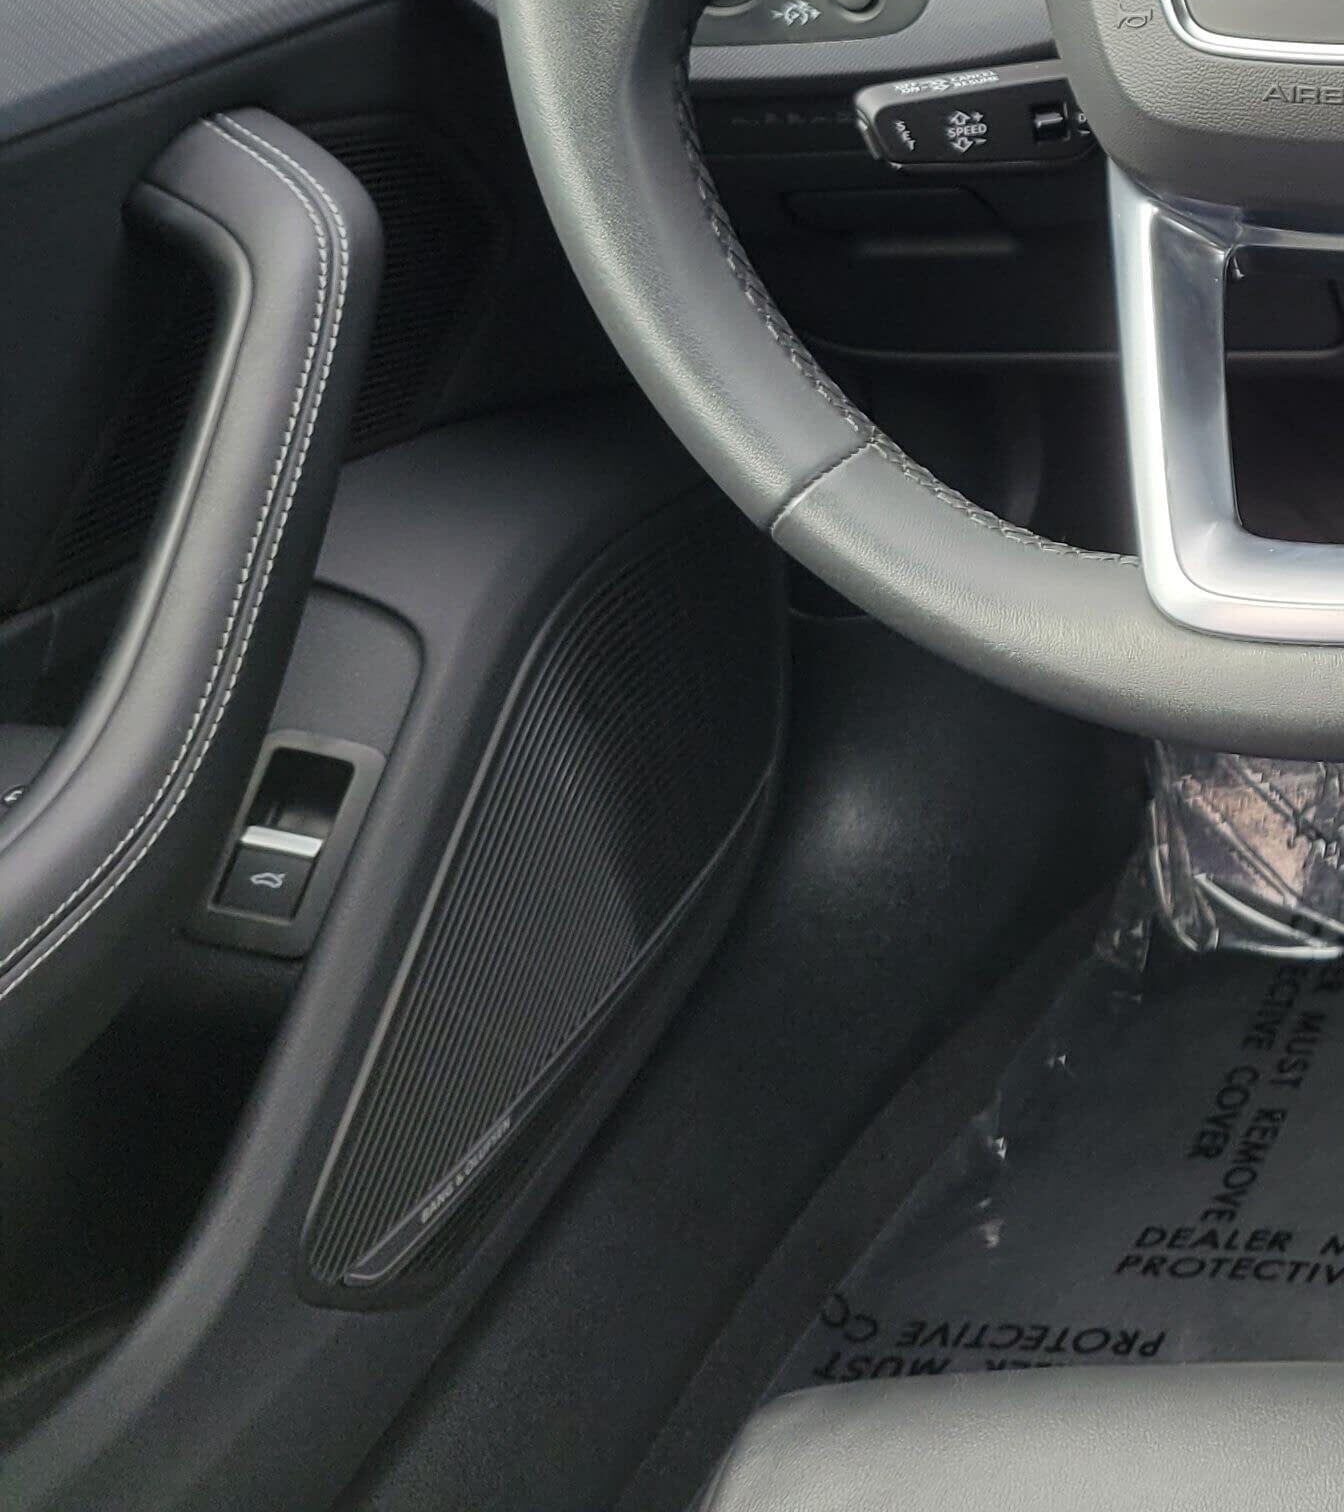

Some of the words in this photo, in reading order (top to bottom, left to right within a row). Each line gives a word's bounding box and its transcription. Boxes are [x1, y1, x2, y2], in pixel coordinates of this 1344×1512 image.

[948, 123, 988, 138] SPEED
[1187, 1065, 1260, 1160] COVER
[1201, 1108, 1288, 1224] REMOVE
[1133, 1225, 1293, 1255] DEALER
[895, 1319, 1167, 1359] PROTECTIVE
